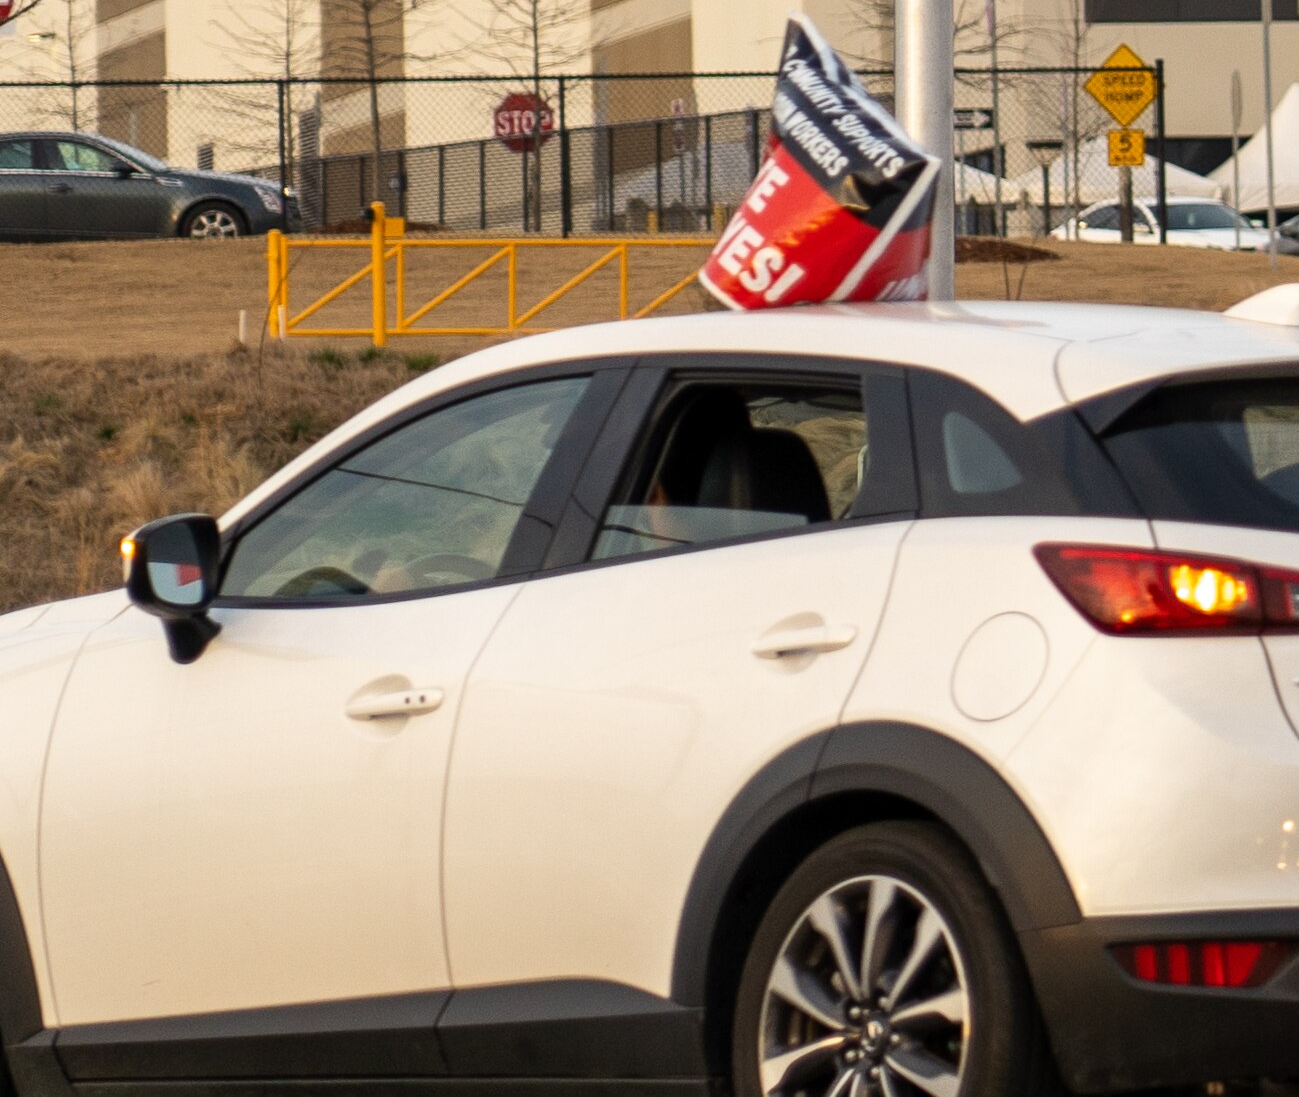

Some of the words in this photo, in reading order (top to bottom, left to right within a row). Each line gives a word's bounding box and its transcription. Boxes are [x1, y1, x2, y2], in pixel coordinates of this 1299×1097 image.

[1103, 74, 1145, 86] SPEED
[498, 110, 551, 135] STOP
[784, 110, 849, 177] WORKERS
[1119, 133, 1132, 152] 5
